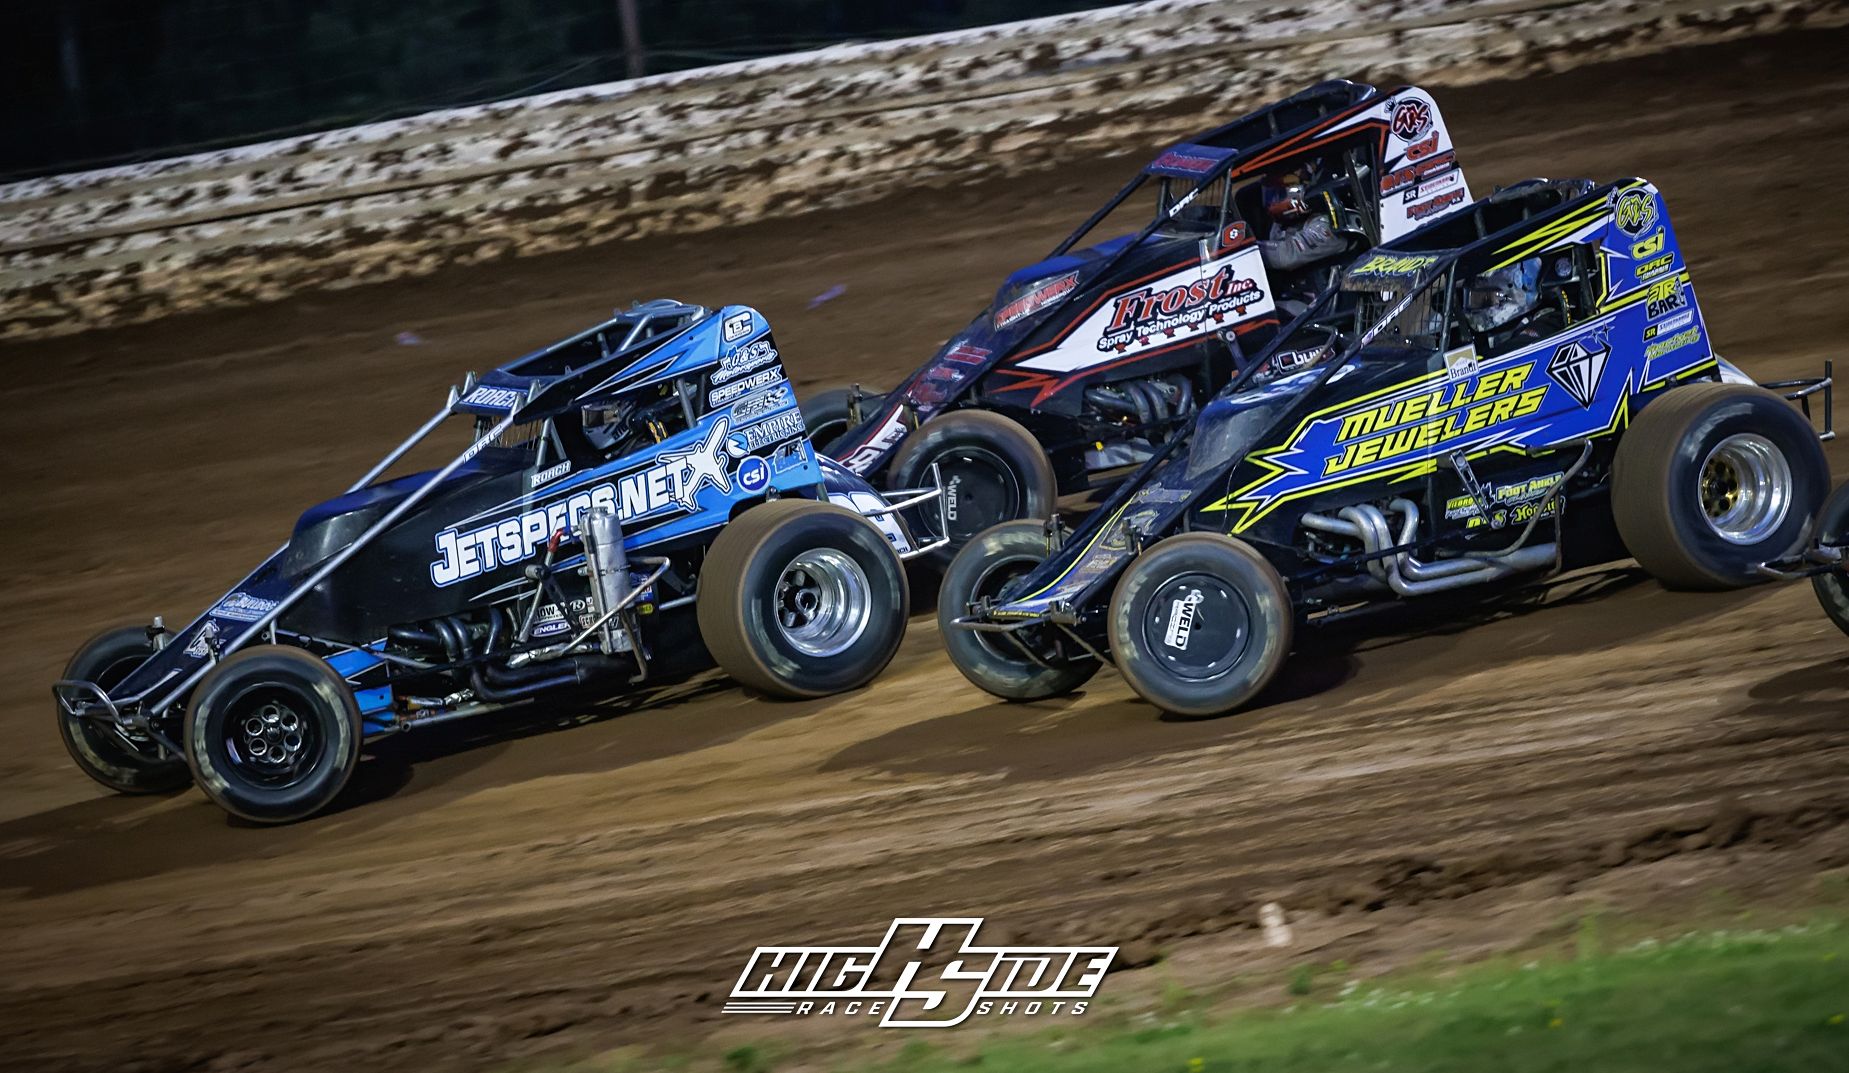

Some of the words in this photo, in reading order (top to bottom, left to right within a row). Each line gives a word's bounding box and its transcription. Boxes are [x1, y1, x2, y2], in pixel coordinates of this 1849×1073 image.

[1106, 266, 1231, 332] Frost
[1226, 278, 1254, 297] Inc.
[1098, 330, 1133, 352] Spray
[1136, 306, 1207, 337] Technology
[1208, 288, 1262, 316] Products
[711, 368, 780, 401] SPEEDWERX
[1450, 361, 1477, 379] Brandt
[463, 386, 528, 408] ROAC
[1336, 362, 1536, 443] MUELLER
[745, 412, 802, 442] EMPIRE
[1324, 386, 1549, 476] JEWELERS
[531, 461, 571, 488] ROACH
[1498, 484, 1527, 500] FOOT
[947, 483, 958, 521] WELD
[1175, 602, 1194, 647] WELD
